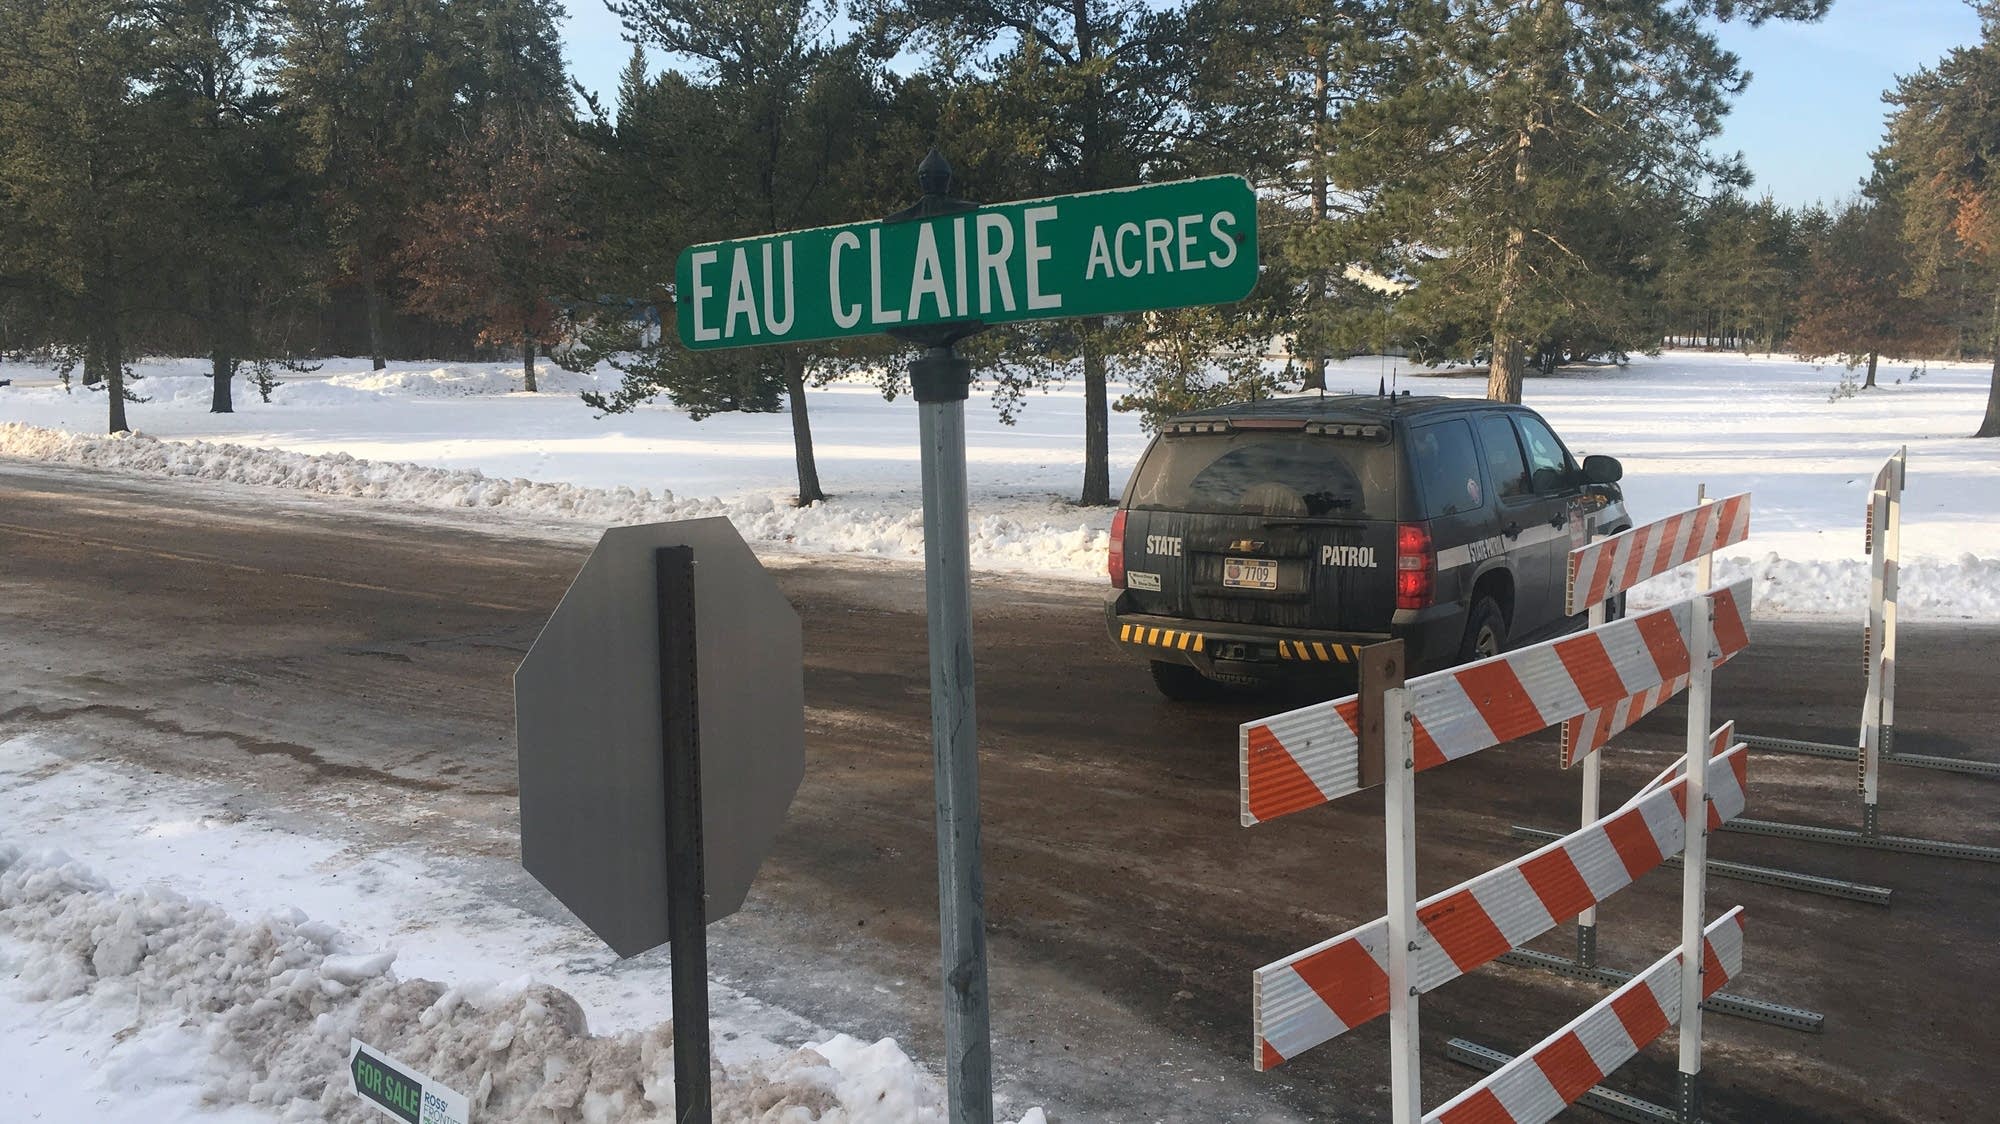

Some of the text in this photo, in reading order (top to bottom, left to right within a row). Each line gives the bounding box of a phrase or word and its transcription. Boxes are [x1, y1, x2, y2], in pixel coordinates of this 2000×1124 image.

[692, 205, 1238, 342] EAU CLAIRE ACRES
[1146, 534, 1378, 568] STATE PATROL
[1245, 566, 1269, 581] 7709
[357, 1058, 419, 1116] FOR SALE
